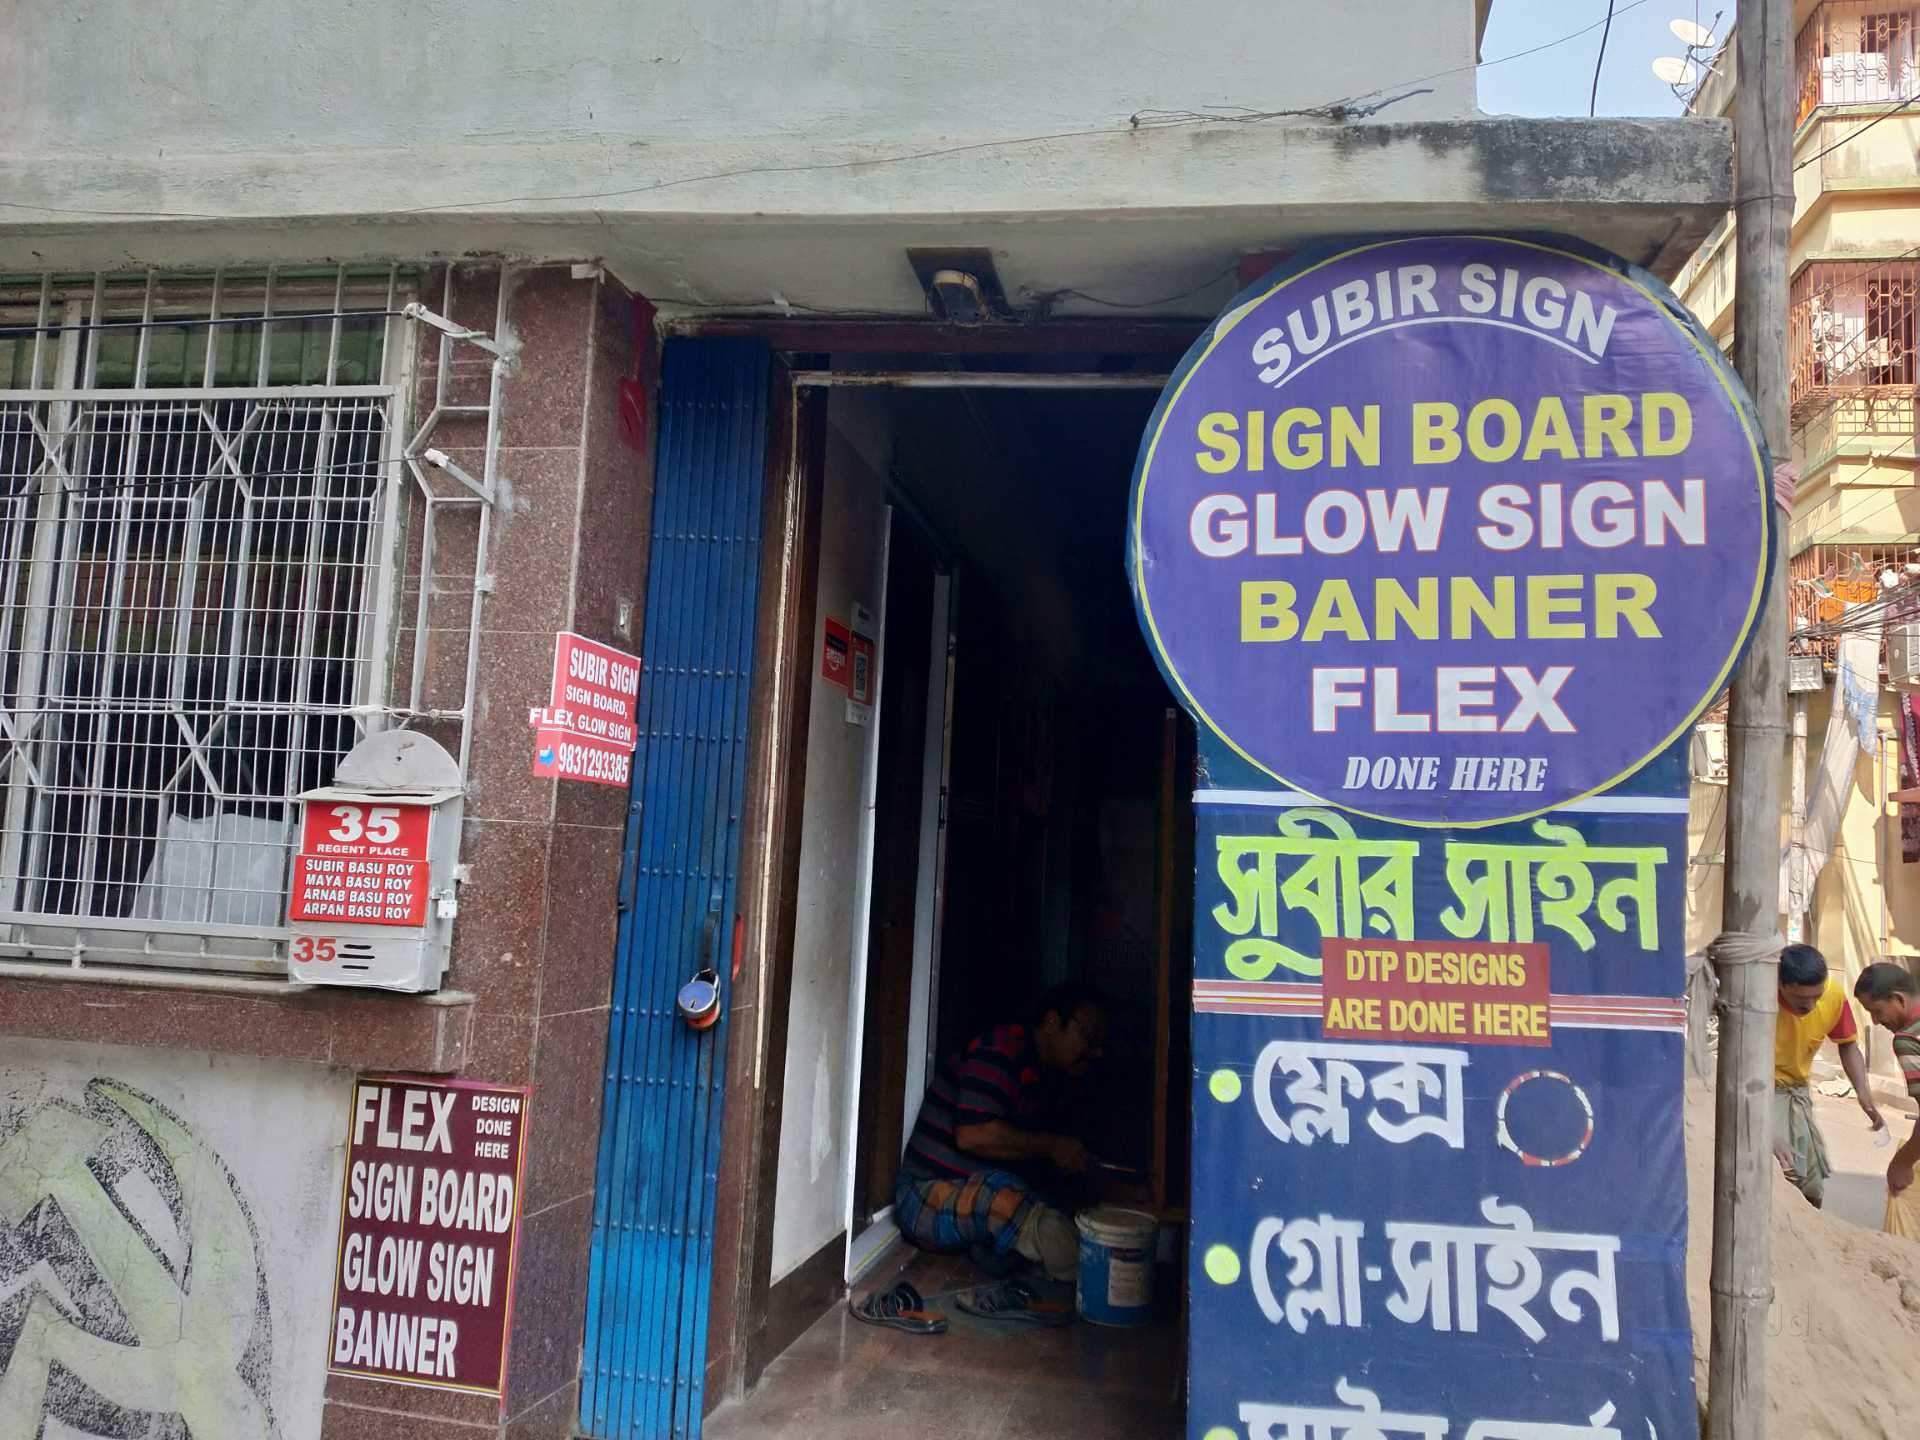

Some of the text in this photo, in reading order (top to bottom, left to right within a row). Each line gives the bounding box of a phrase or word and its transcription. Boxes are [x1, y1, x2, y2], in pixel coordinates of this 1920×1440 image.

[1251, 262, 1616, 385] SUBIR SIGN
[1195, 393, 1693, 474] SIGN BOARD
[1190, 479, 1706, 558] GLOW SIGN
[1240, 573, 1663, 643] BANNER
[570, 647, 639, 696] SUBIR SIGN
[566, 685, 628, 720] SIGN BOARD,
[1311, 666, 1577, 734] FLEX
[578, 714, 606, 735] GLOW
[608, 722, 631, 741] SIGN
[558, 742, 629, 783] 9831293385
[1344, 756, 1549, 792] DONE HERE
[328, 806, 401, 844] 35
[305, 860, 414, 876] SUBIR BASU ROY
[317, 844, 409, 857] REGENT PLACE
[304, 889, 413, 906] ARNAB BASU ROY
[305, 874, 412, 891] MAYA BASU ROY
[1212, 807, 1668, 981] সুবীর সাইন
[303, 902, 411, 920] ARPAN BASU ROY
[293, 936, 337, 963] 35
[1346, 950, 1526, 987] DTP DESIGNS
[1326, 999, 1548, 1038] ARE DONE HERE
[471, 1095, 520, 1115] DESIGN
[1252, 1040, 1469, 1149] ফ্লেক্স
[353, 1085, 457, 1154] FLEX
[476, 1118, 512, 1137] DONE
[474, 1141, 509, 1159] HERE
[349, 1160, 514, 1233] SIGN BOARD
[343, 1232, 494, 1307] GLOW SIGN
[334, 1306, 458, 1378] BANNER
